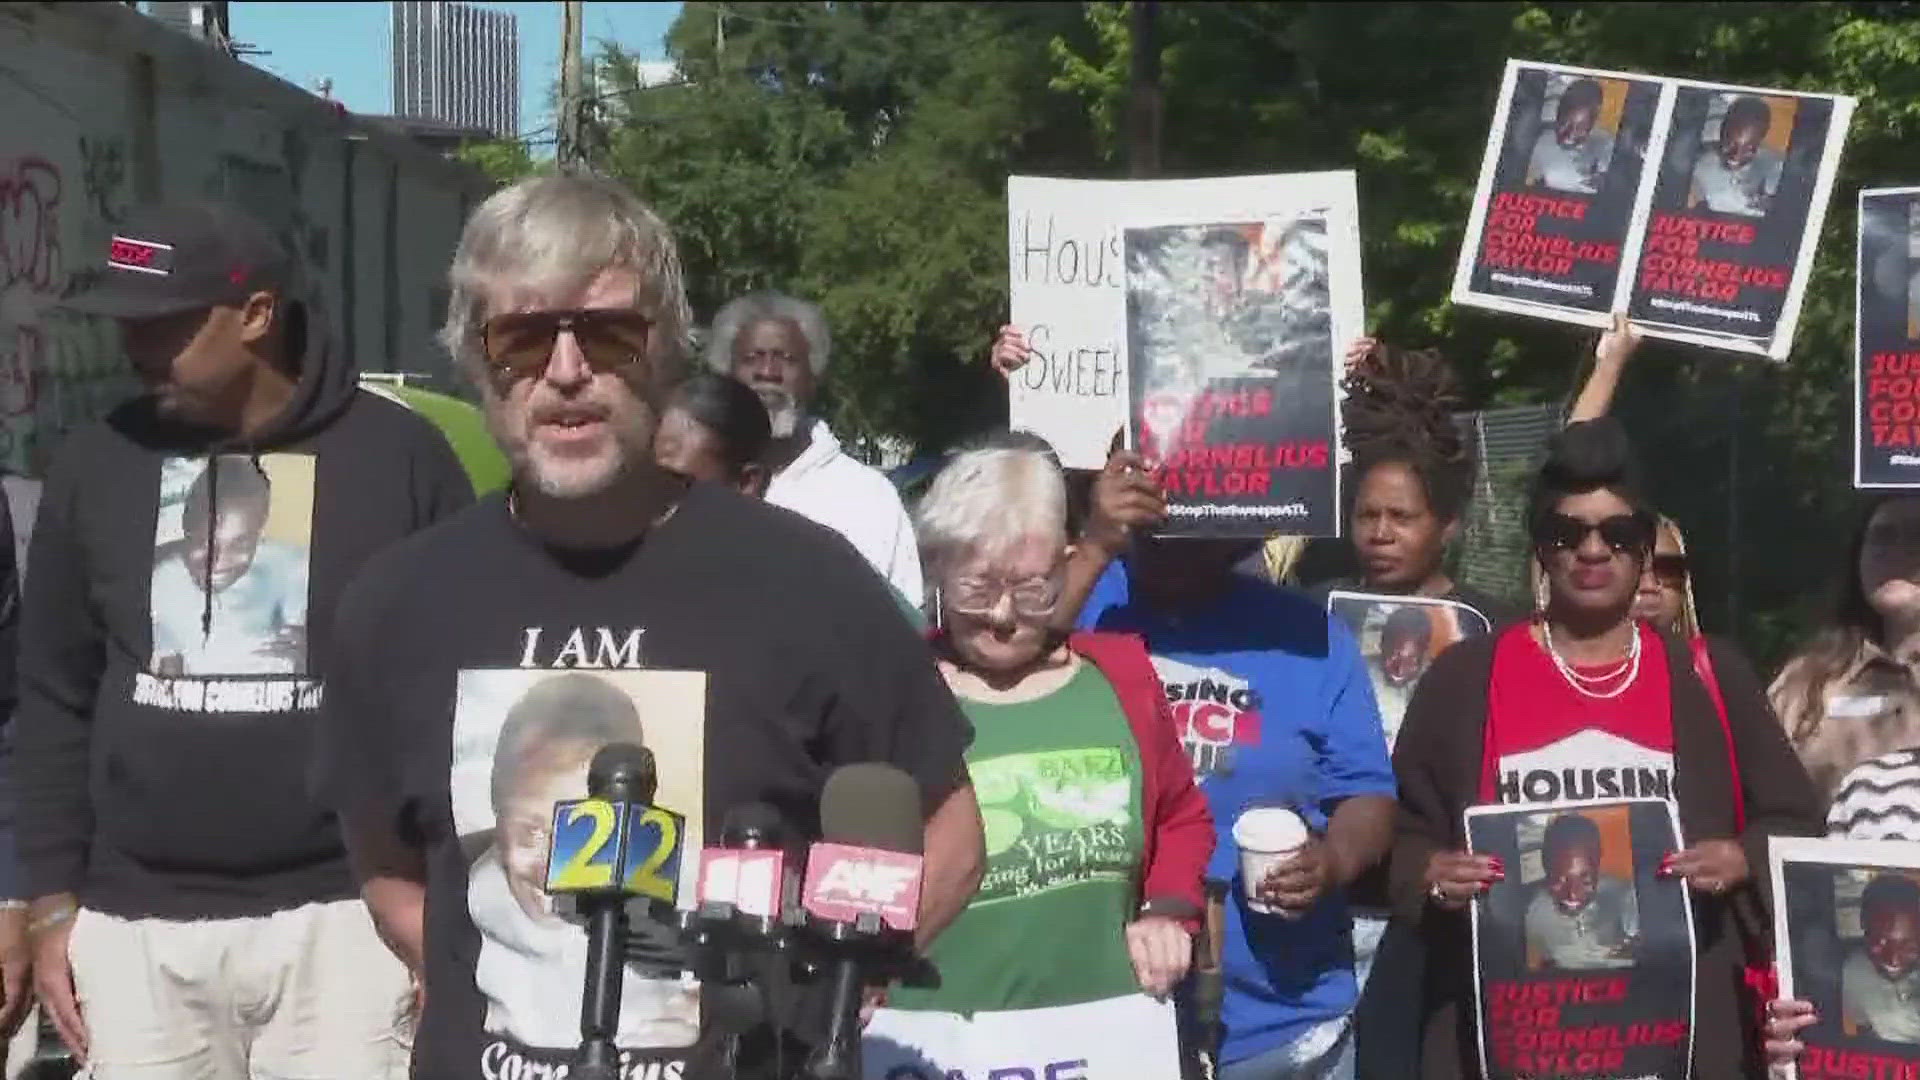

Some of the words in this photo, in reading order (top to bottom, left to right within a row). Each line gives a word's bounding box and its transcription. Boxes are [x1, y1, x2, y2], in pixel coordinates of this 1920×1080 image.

[1488, 212, 1536, 231] FOR
[1494, 193, 1589, 220] JUSTICE
[1648, 235, 1698, 257] FOR
[1655, 215, 1757, 246] JUSTICE
[1483, 248, 1574, 275] TAYLOR
[1486, 231, 1619, 262] CORNELIUS
[1640, 271, 1740, 302] TAYLOR
[1643, 253, 1788, 289] CORNELIUS
[1869, 401, 1920, 424] CO
[519, 628, 542, 669] I
[552, 628, 646, 669] AM
[551, 800, 617, 890] 2
[624, 810, 678, 901] 2
[1489, 973, 1631, 1005] JUSTICE
[1495, 1020, 1688, 1052] CORNELIUS
